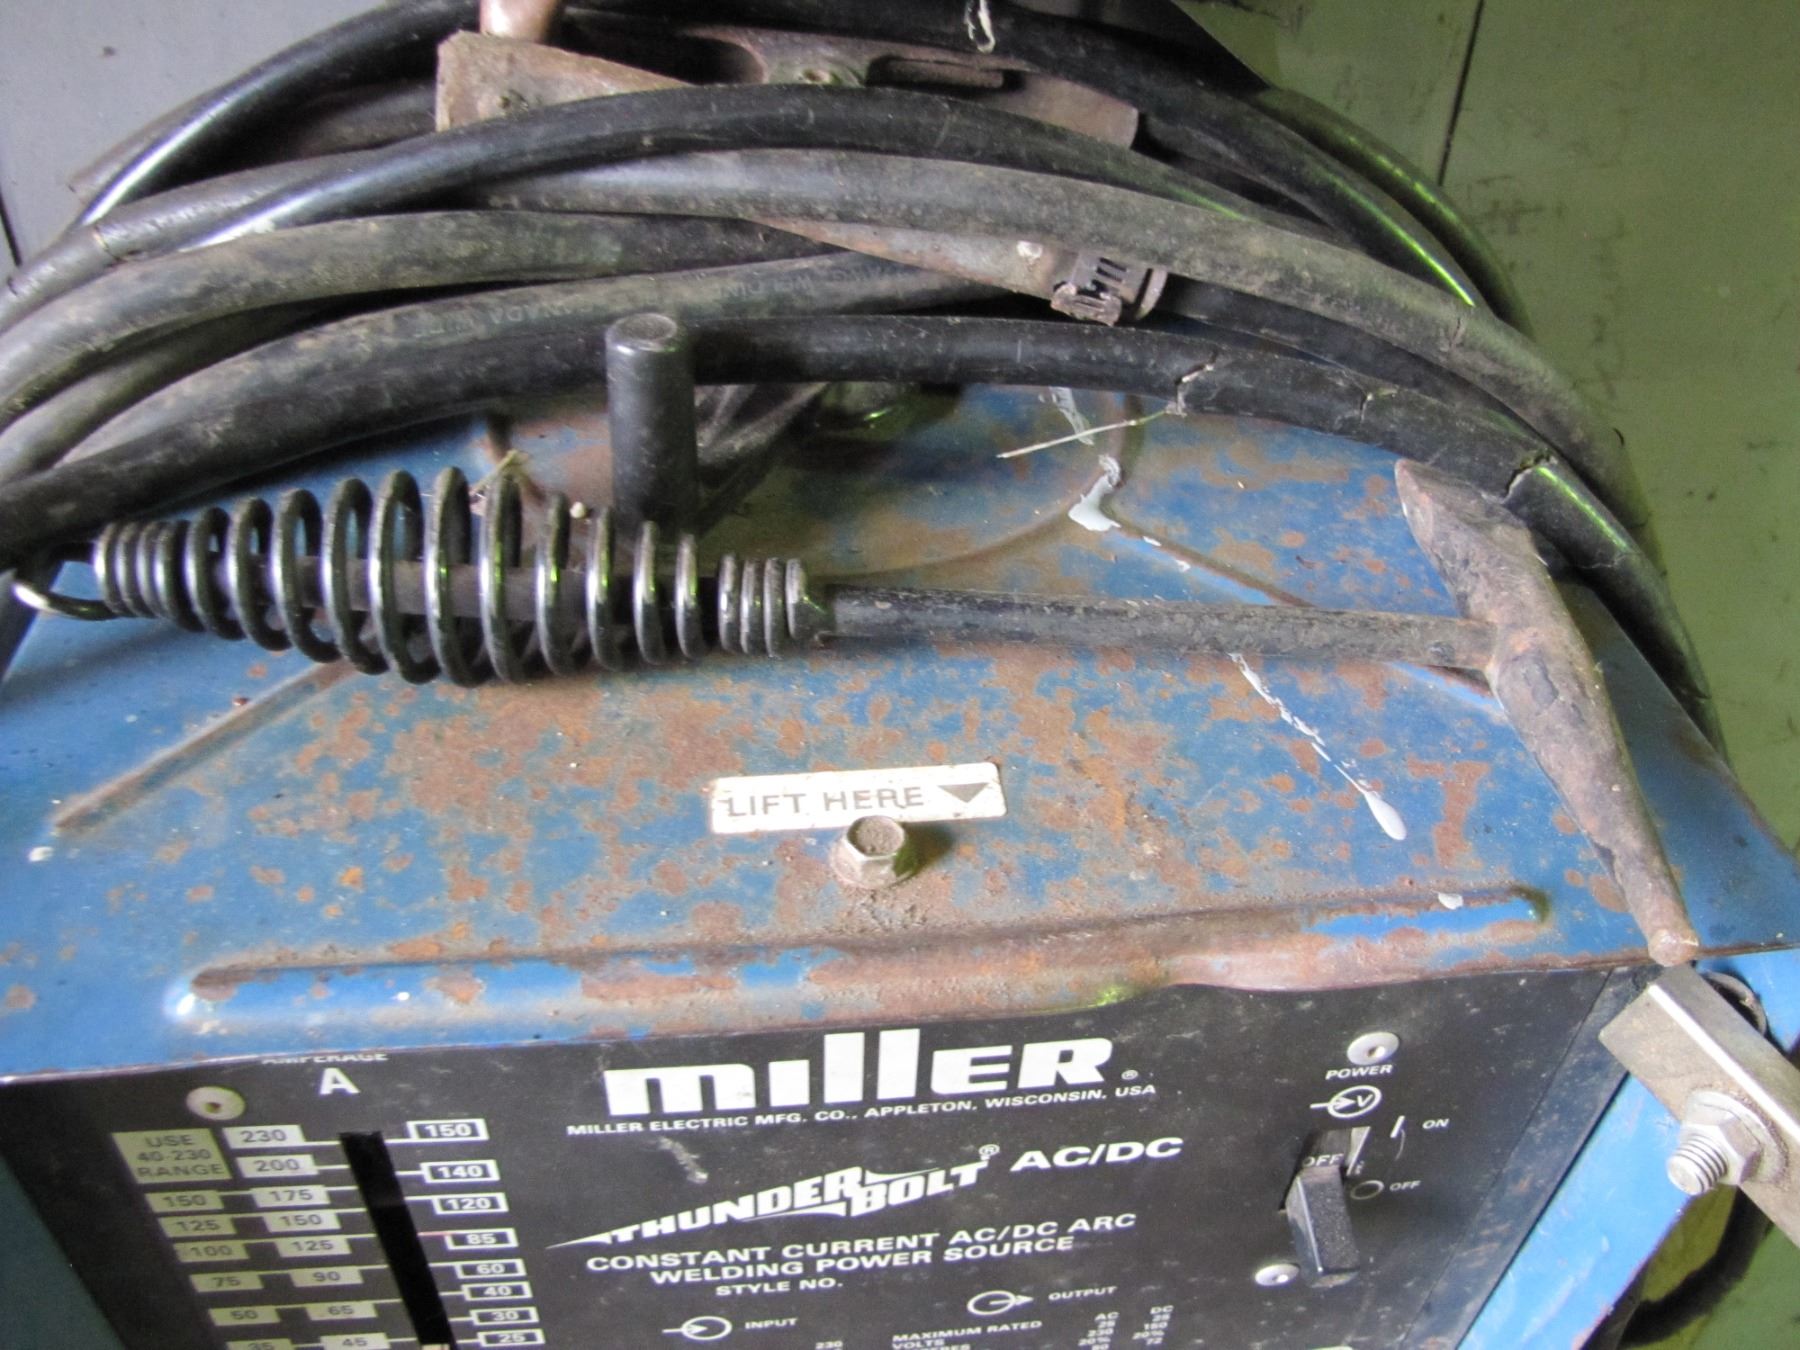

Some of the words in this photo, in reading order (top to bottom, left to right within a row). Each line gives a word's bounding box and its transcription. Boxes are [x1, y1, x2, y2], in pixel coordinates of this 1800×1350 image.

[727, 793, 806, 817] LIFT
[823, 786, 924, 812] HERE
[1325, 1064, 1393, 1080] POWER
[319, 1067, 360, 1095] A
[1355, 1094, 1374, 1108] V
[566, 1122, 643, 1136] MILLER
[650, 1115, 748, 1132] ELECTRIC
[755, 1112, 807, 1125] MFG.
[1115, 1084, 1156, 1097] USA
[425, 1123, 471, 1137] 150
[1422, 1118, 1449, 1130] ON
[146, 1134, 194, 1147] USE
[240, 1129, 287, 1143] 230
[1010, 1137, 1184, 1171] AC/DC
[1303, 1153, 1344, 1167] OFF
[137, 1163, 223, 1177] RANGE
[253, 1159, 299, 1172] 200
[438, 1165, 483, 1178] 140
[1389, 1180, 1421, 1192] OFF
[163, 1195, 206, 1206] 150
[271, 1189, 312, 1201] 175
[448, 1198, 490, 1209] 120
[178, 1219, 220, 1231] 125
[281, 1214, 321, 1226] 150
[466, 1233, 497, 1245] 85
[586, 1246, 772, 1272] CONSTANT
[781, 1233, 940, 1259] CURRENT
[949, 1221, 1058, 1245] AC/DC
[1067, 1213, 1137, 1232] ARC
[191, 1245, 232, 1257] 100
[293, 1240, 334, 1251] 125
[650, 1261, 804, 1285] WELDING
[816, 1250, 932, 1274] POWER
[943, 1236, 1075, 1262] SOURCE
[476, 1264, 504, 1274] 60
[213, 1276, 240, 1287] 75
[313, 1271, 340, 1282] 90
[484, 1286, 512, 1296] 40
[715, 1281, 791, 1296] STYLE
[799, 1277, 844, 1290] NO.
[1048, 1286, 1118, 1300] OUTPUT
[231, 1309, 258, 1320] 50
[328, 1305, 355, 1316] 65
[492, 1312, 519, 1321] 30
[1095, 1311, 1119, 1321] AC
[1150, 1305, 1173, 1314] DC
[745, 1317, 798, 1330] INPUT
[892, 1327, 982, 1342] MAXIMUM
[987, 1320, 1043, 1333] RATED
[342, 1337, 367, 1348] 45
[499, 1333, 526, 1343] 25
[892, 1339, 945, 1349] VOLTS
